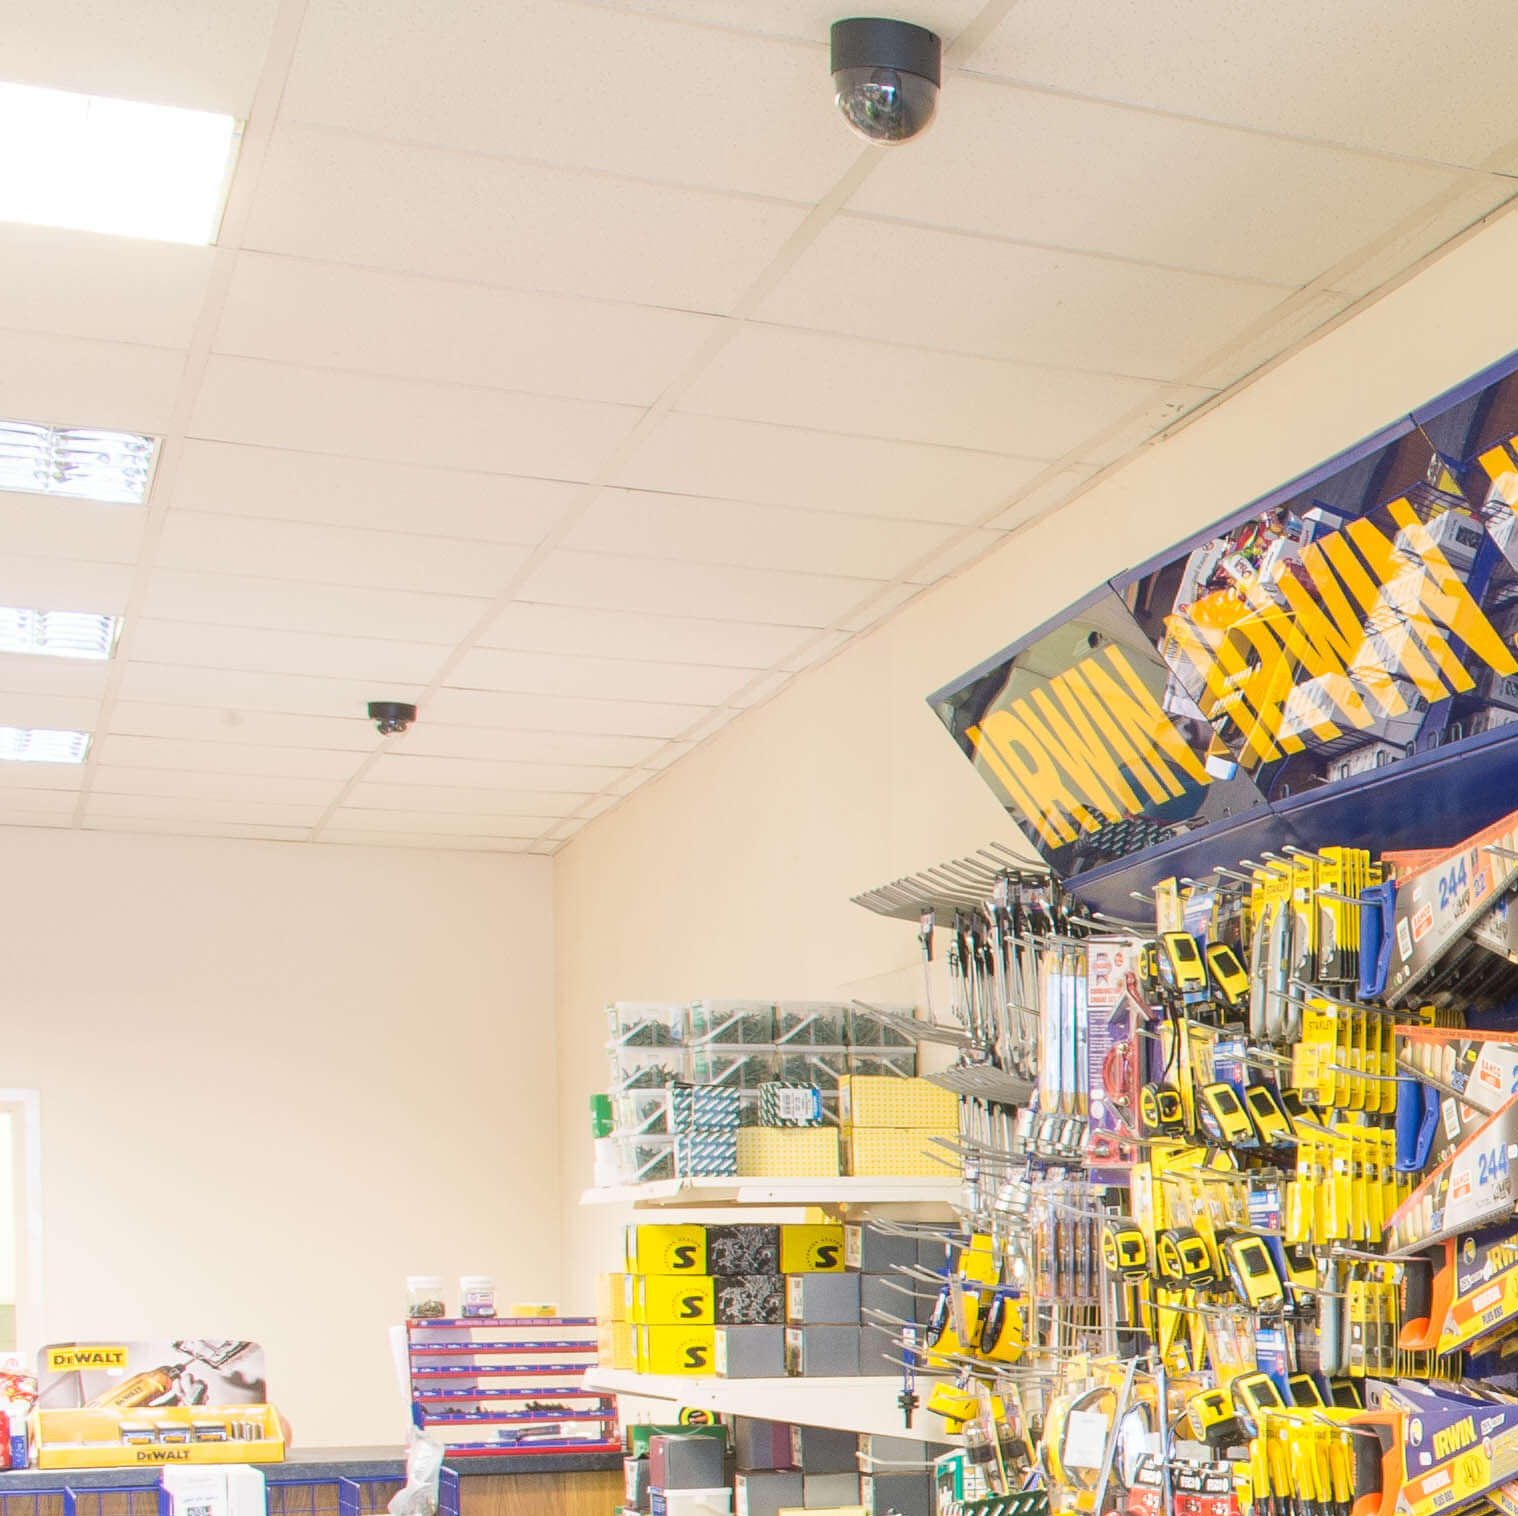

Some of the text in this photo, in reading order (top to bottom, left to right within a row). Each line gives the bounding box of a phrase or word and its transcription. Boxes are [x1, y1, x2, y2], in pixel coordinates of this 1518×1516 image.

[965, 645, 1212, 849] IRWIN
[1438, 858, 1467, 912] 244
[1478, 1144, 1509, 1186] 244
[53, 1352, 124, 1366] DEWALT
[136, 1450, 191, 1462] DEWALT
[1433, 1415, 1477, 1461] IRWIN
